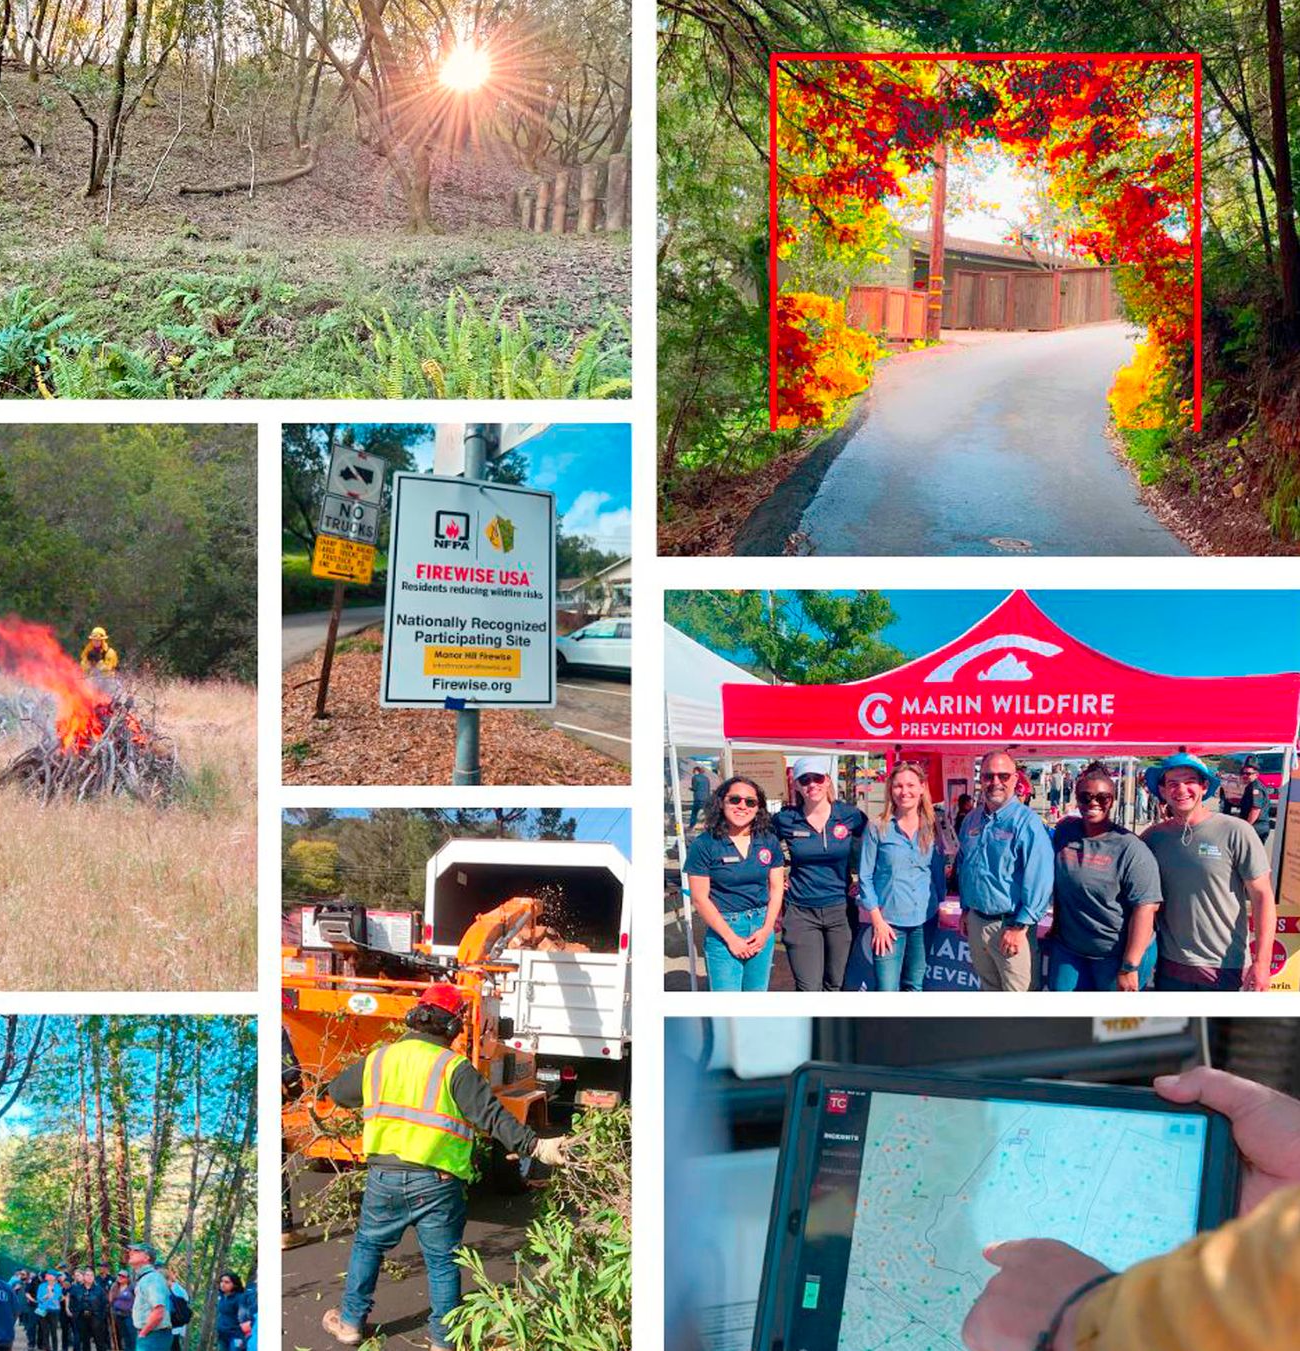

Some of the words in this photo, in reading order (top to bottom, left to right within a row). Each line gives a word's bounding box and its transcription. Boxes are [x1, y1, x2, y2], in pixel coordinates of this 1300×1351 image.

[340, 503, 364, 520] NO
[325, 515, 374, 538] TRUCKS
[434, 539, 470, 551] NFPA
[416, 563, 495, 584] FIREWISE
[499, 570, 530, 586] USA
[401, 581, 448, 593] Residents
[449, 585, 488, 597] reducing
[490, 587, 521, 598] wildfire
[523, 590, 544, 600] risks
[396, 614, 467, 630] Nationally
[471, 617, 547, 633] Recognized
[415, 631, 502, 648] Participating
[506, 634, 531, 647] Site
[465, 651, 477, 659] Hill
[480, 652, 512, 661] Firewise
[432, 678, 512, 694] Firewise.org
[901, 695, 982, 714] MARIN
[992, 694, 1115, 715] WILDFIRE
[901, 722, 1003, 737] PREVENTION
[1012, 722, 1113, 737] AUTHORITY
[1269, 982, 1292, 990] arin
[829, 1097, 847, 1109] TC
